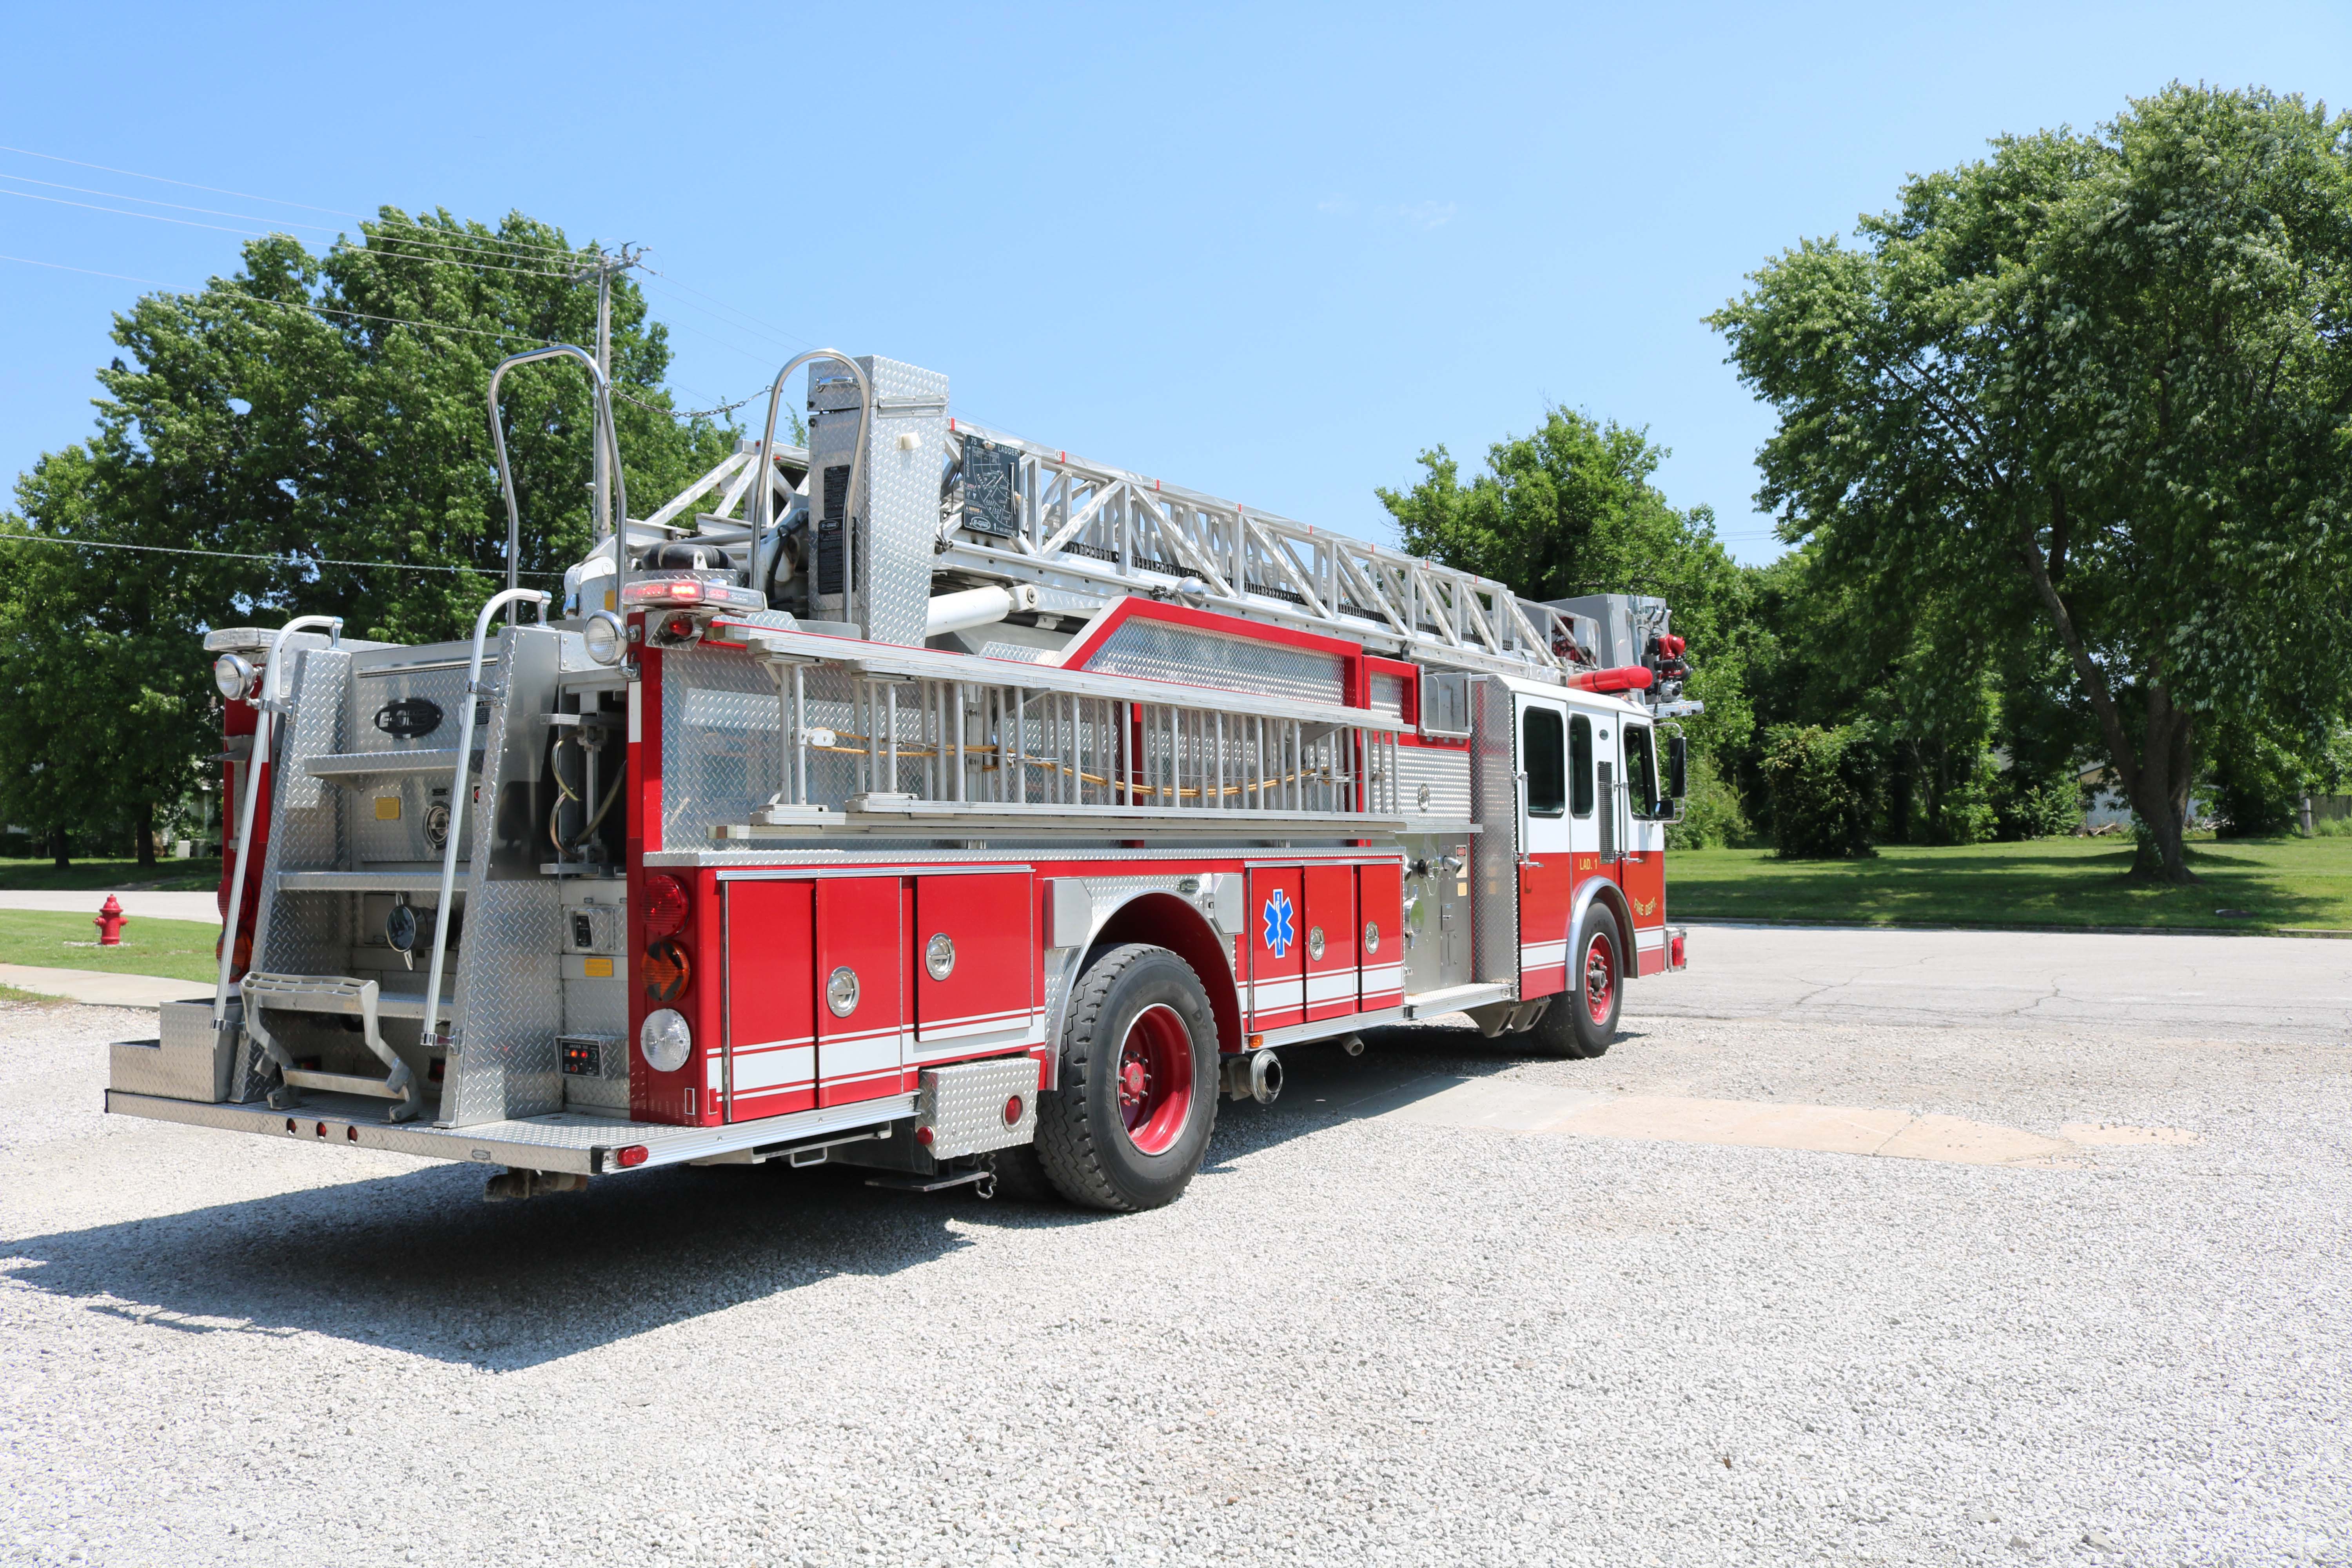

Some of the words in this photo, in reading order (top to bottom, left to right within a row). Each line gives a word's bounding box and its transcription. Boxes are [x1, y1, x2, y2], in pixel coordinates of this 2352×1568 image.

[971, 437, 977, 445] 75
[998, 445, 1018, 457] LADDER
[1056, 450, 1061, 459] 45
[1151, 479, 1156, 487] 50
[379, 710, 428, 728] E-ONE
[1579, 858, 1592, 870] LAD.
[1595, 858, 1597, 869] 1
[1634, 897, 1644, 916] FIRE
